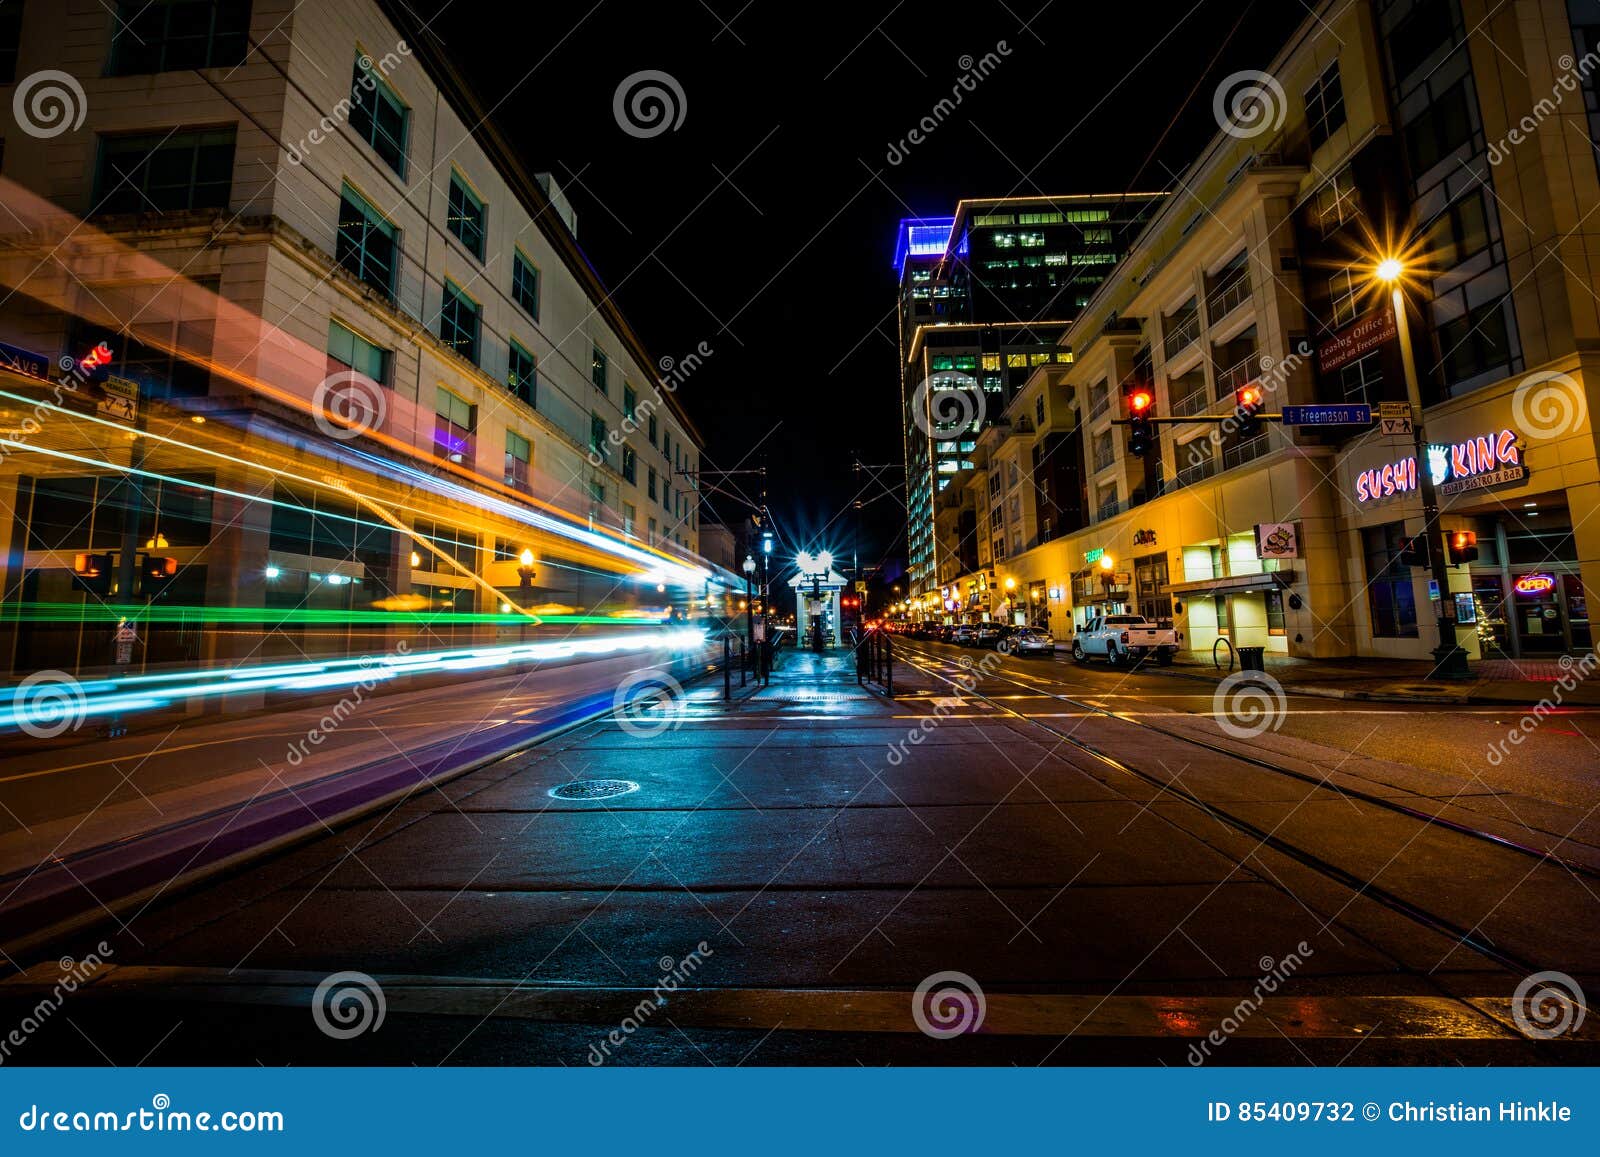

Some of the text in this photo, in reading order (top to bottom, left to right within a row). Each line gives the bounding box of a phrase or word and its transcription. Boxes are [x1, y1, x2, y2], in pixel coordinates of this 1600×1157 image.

[1320, 318, 1383, 358] Leasing Office
[1321, 352, 1346, 371] Located
[1357, 327, 1396, 352] Freemason
[12, 355, 39, 375] Ave
[1300, 407, 1349, 423] Freemason
[1356, 410, 1364, 421] St
[1356, 429, 1519, 502] SUSHI KING
[1518, 579, 1550, 590] OPEN
